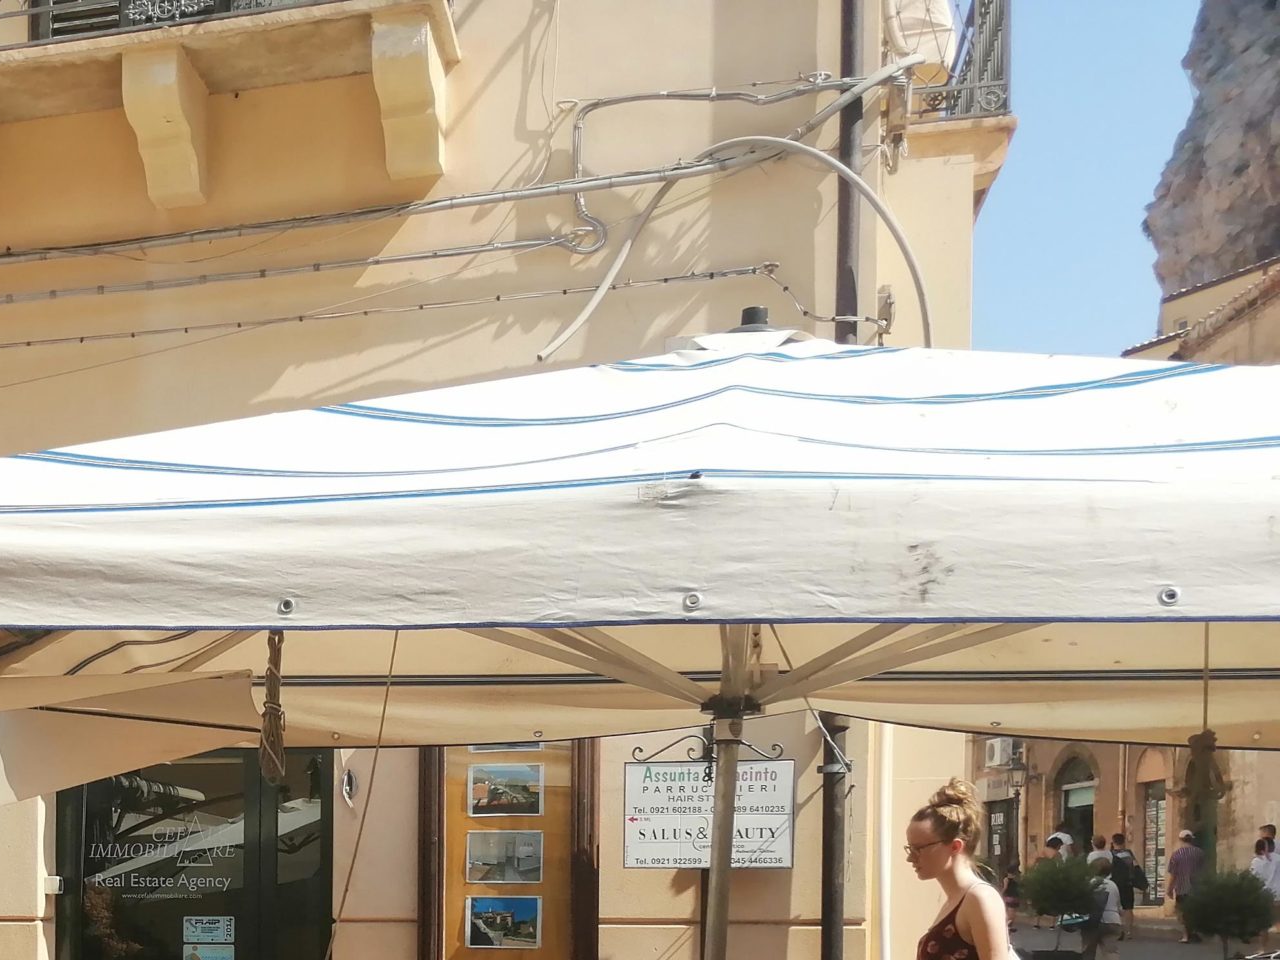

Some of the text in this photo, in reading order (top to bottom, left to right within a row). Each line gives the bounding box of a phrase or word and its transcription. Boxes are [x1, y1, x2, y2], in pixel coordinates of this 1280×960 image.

[643, 765, 699, 783] Assunta
[736, 767, 777, 782] acinto
[642, 784, 777, 794] PARRUCIERI
[633, 806, 647, 814] Tel.
[649, 806, 669, 814] 0921
[672, 806, 702, 814] 602188
[749, 805, 786, 813] 6410235
[638, 826, 780, 841] SALUS & AUTY
[635, 858, 649, 866] Tel.
[651, 857, 670, 865] 0921
[672, 857, 702, 865] 922599
[95, 872, 231, 891] Real Estate Agency
